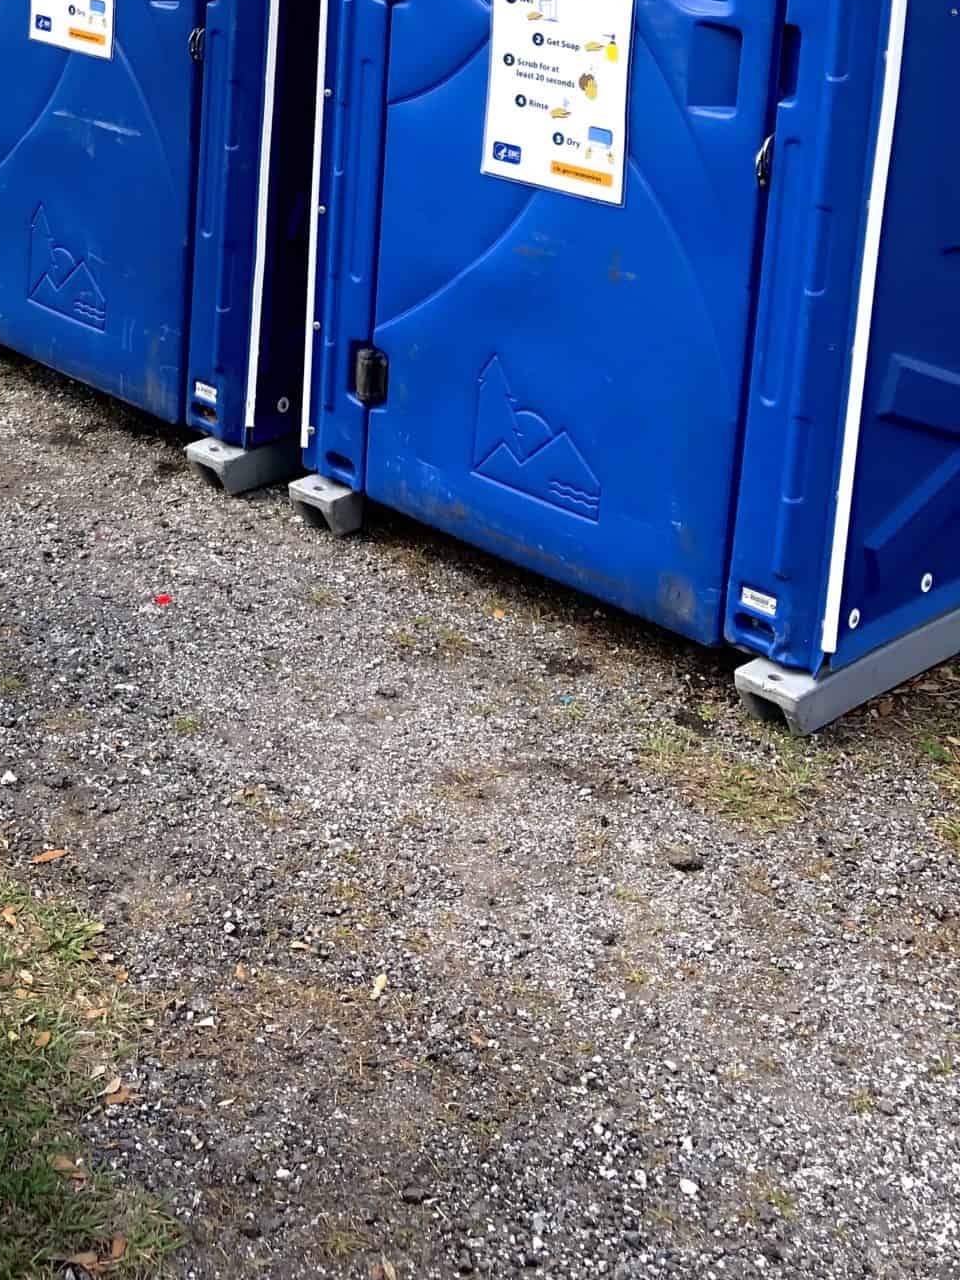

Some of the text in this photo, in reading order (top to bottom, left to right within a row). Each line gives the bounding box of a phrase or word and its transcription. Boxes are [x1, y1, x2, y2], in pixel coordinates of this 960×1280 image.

[547, 38, 560, 47] Get
[561, 40, 581, 53] Soap
[517, 57, 539, 69] Scrub
[539, 61, 550, 72] for
[551, 65, 559, 73] at
[546, 76, 576, 89] seconds
[566, 138, 581, 149] Dry
